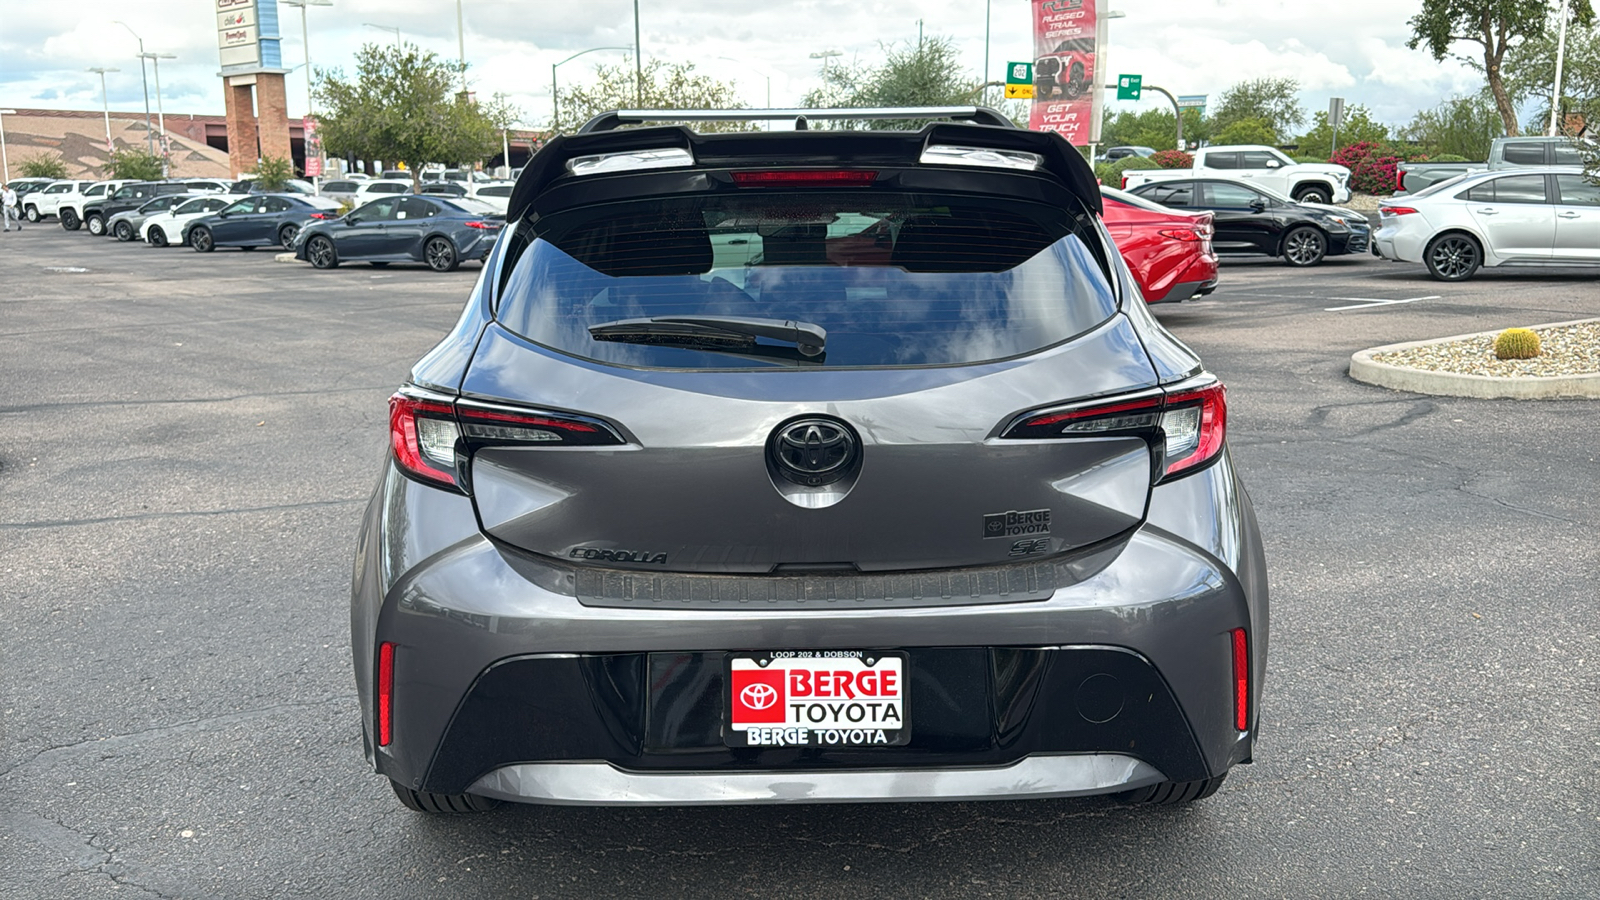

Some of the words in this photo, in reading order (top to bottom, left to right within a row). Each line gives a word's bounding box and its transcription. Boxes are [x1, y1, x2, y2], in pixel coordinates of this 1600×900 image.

[1042, 11, 1085, 23] RUGGED
[1049, 20, 1077, 30] TRAIL
[1045, 28, 1082, 38] SERIES
[1047, 103, 1073, 113] GET
[1042, 113, 1077, 123] YOUR
[1039, 122, 1080, 132] TRUCK
[1006, 510, 1050, 526] BERGE
[1006, 523, 1049, 535] TOYOTA
[1008, 537, 1050, 556] SE
[569, 547, 668, 564] COROLLA
[789, 669, 898, 700] BERGE
[790, 703, 901, 723] TOYOTA
[747, 727, 809, 746] BERGE
[814, 729, 888, 744] TOYOTA
